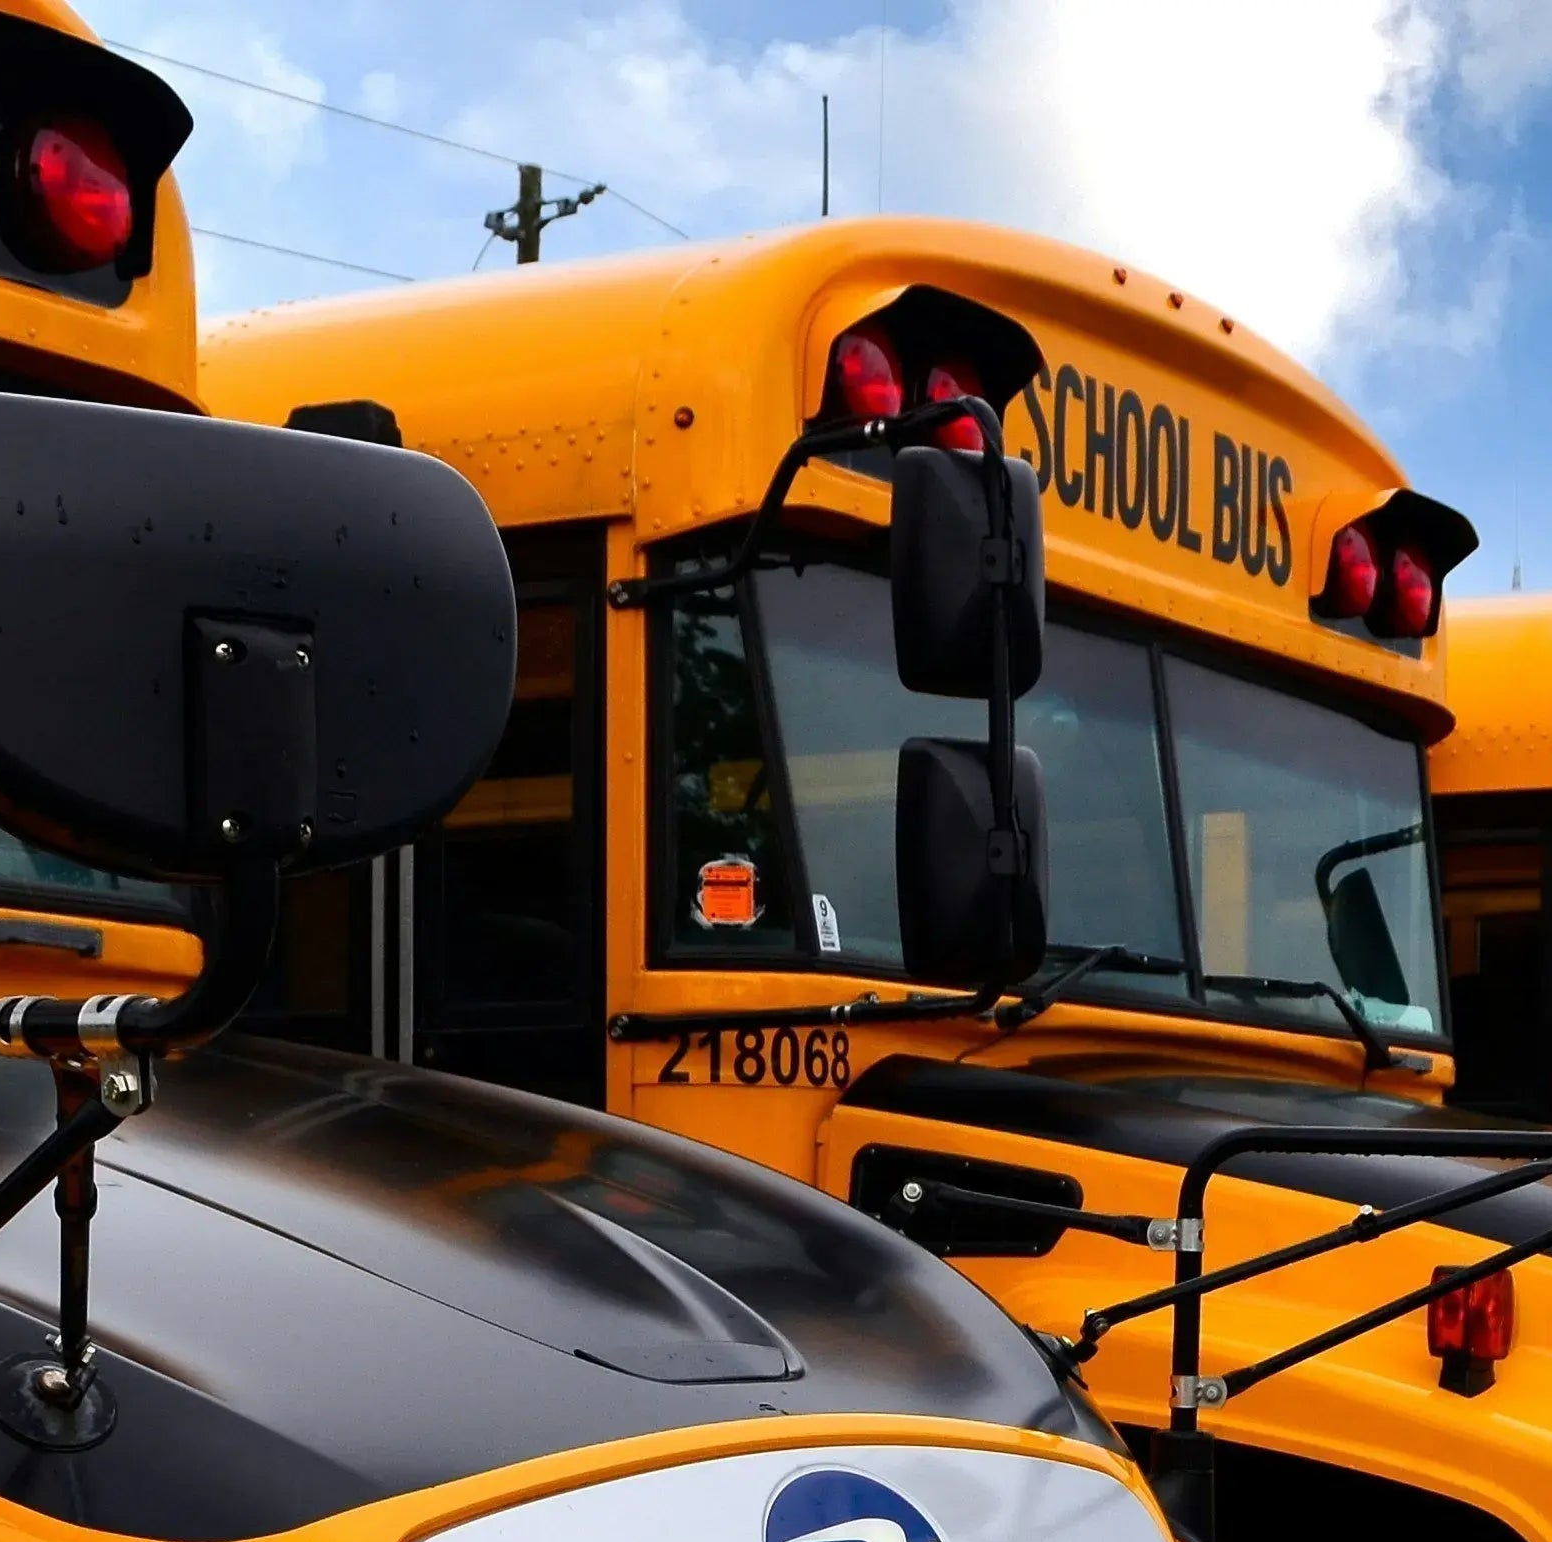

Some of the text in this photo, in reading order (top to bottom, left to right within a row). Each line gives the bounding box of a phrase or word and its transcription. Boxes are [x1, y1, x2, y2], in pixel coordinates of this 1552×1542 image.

[1020, 361, 1293, 587] SCHOOL BUS
[819, 900, 828, 917] 9
[657, 1025, 850, 1089] 218068
